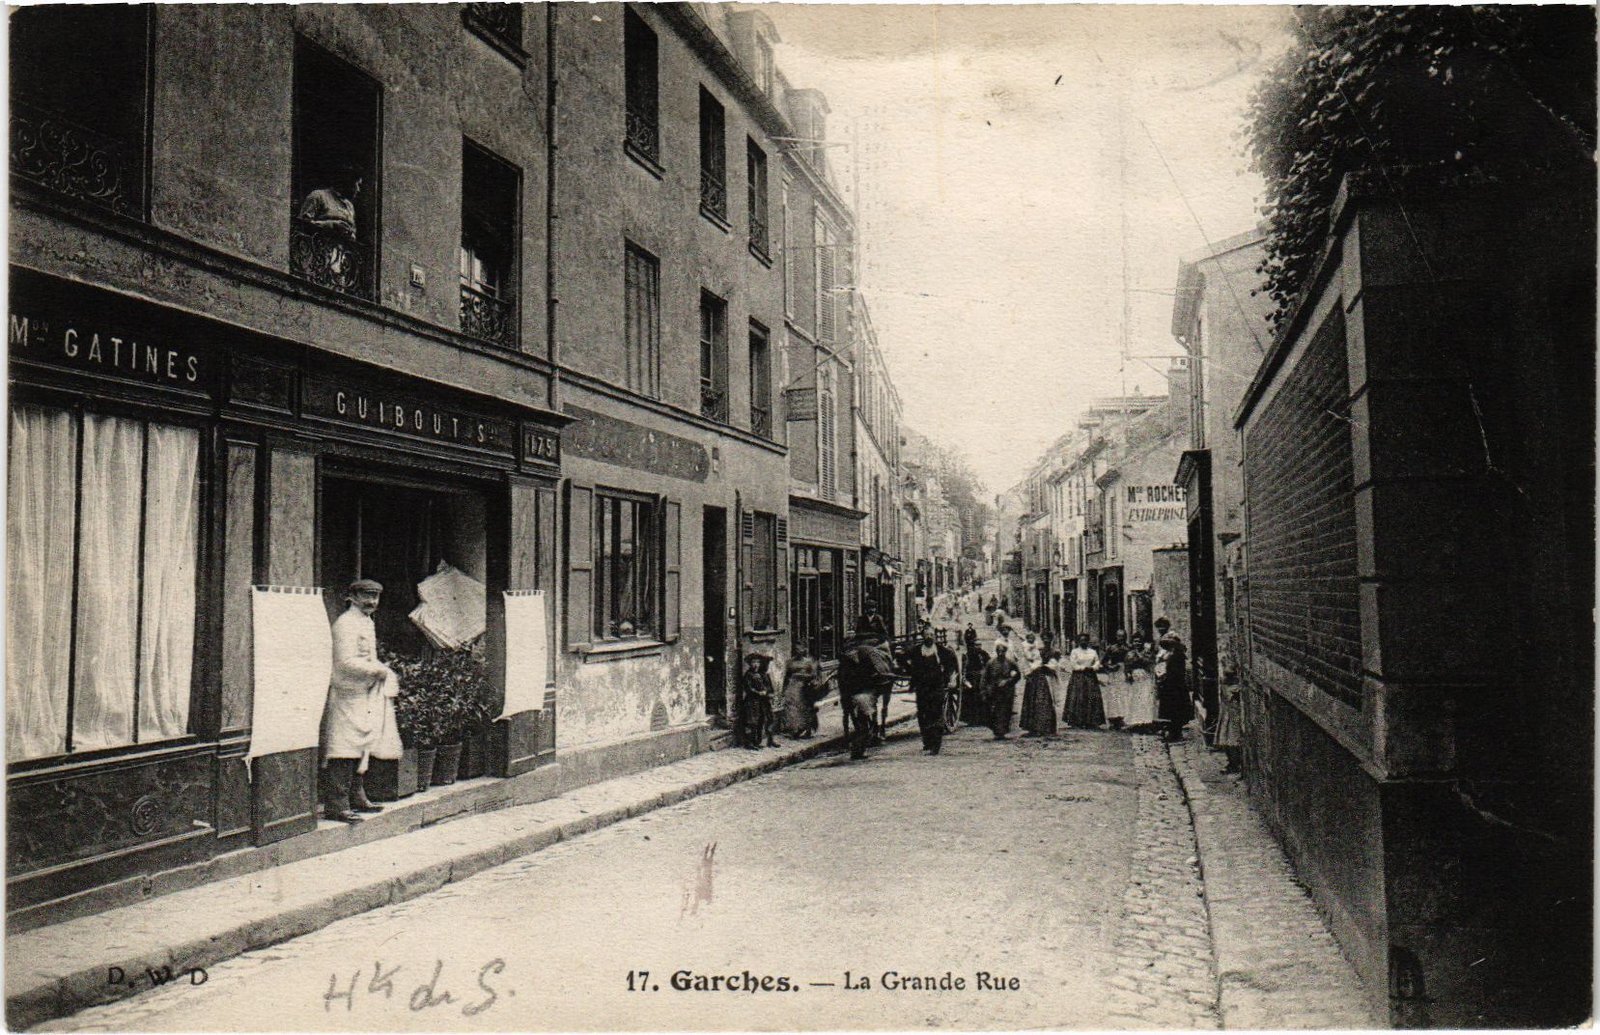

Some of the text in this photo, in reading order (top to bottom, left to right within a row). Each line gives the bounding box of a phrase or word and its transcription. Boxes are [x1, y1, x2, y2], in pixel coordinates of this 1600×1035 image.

[64, 328, 199, 382] GATINES
[336, 391, 459, 438] GUIBOUT
[531, 434, 552, 457] 175
